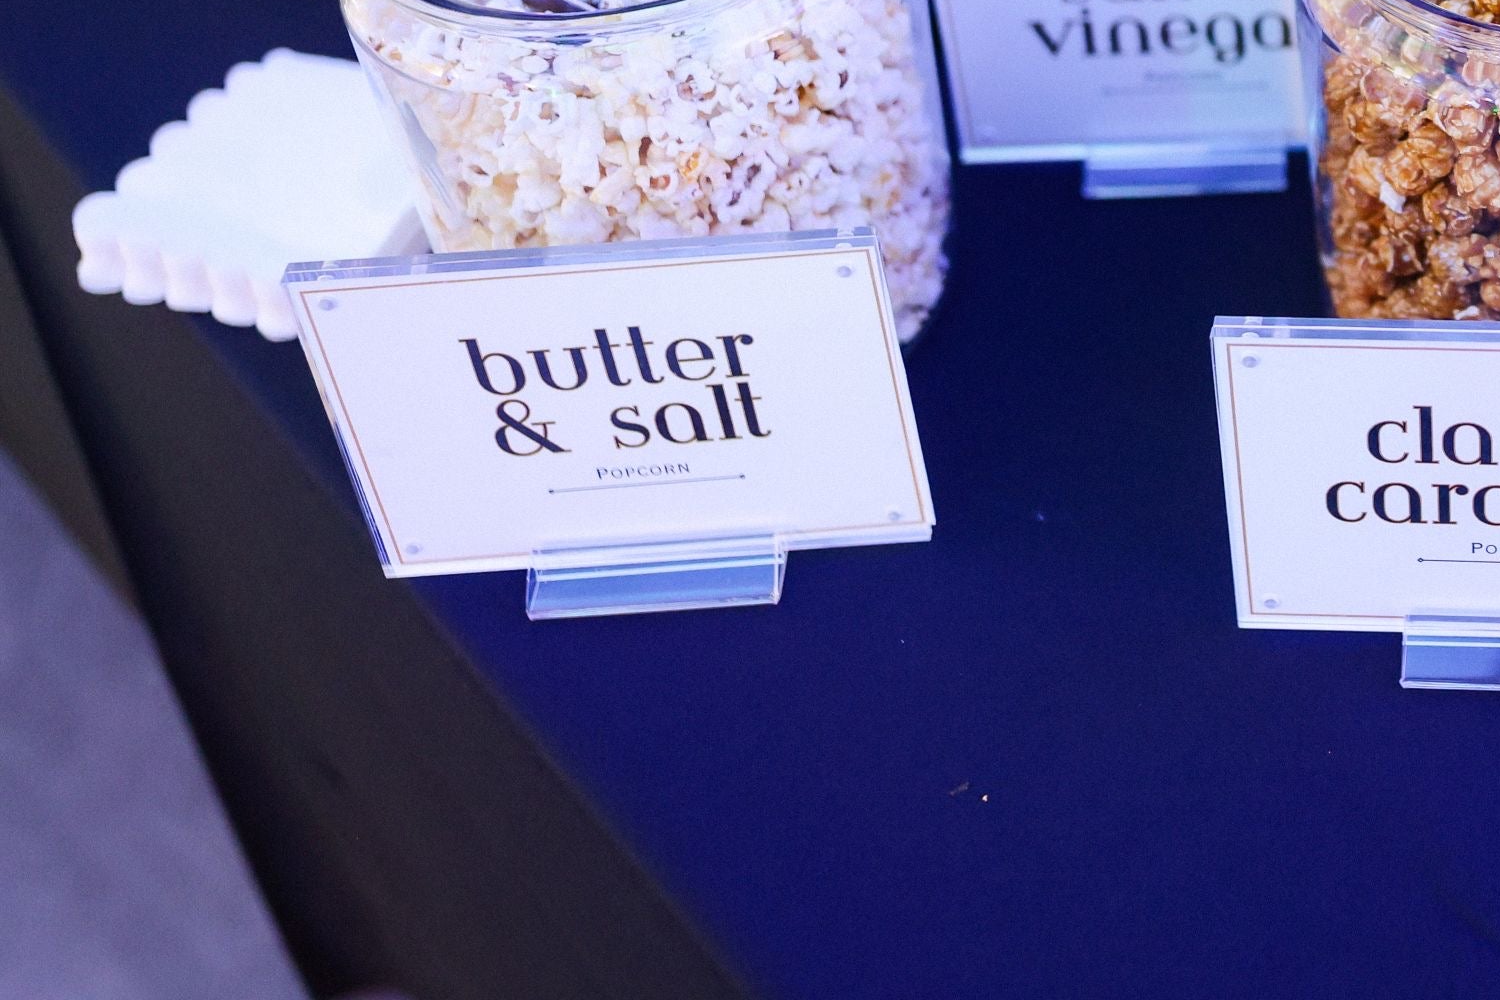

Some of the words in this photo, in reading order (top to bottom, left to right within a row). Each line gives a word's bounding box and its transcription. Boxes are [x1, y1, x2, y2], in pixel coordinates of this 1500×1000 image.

[1028, 8, 1294, 65] vinega
[457, 325, 755, 396] butter
[493, 398, 573, 458] &
[608, 381, 772, 451] salt
[596, 462, 691, 480] POPCORN
